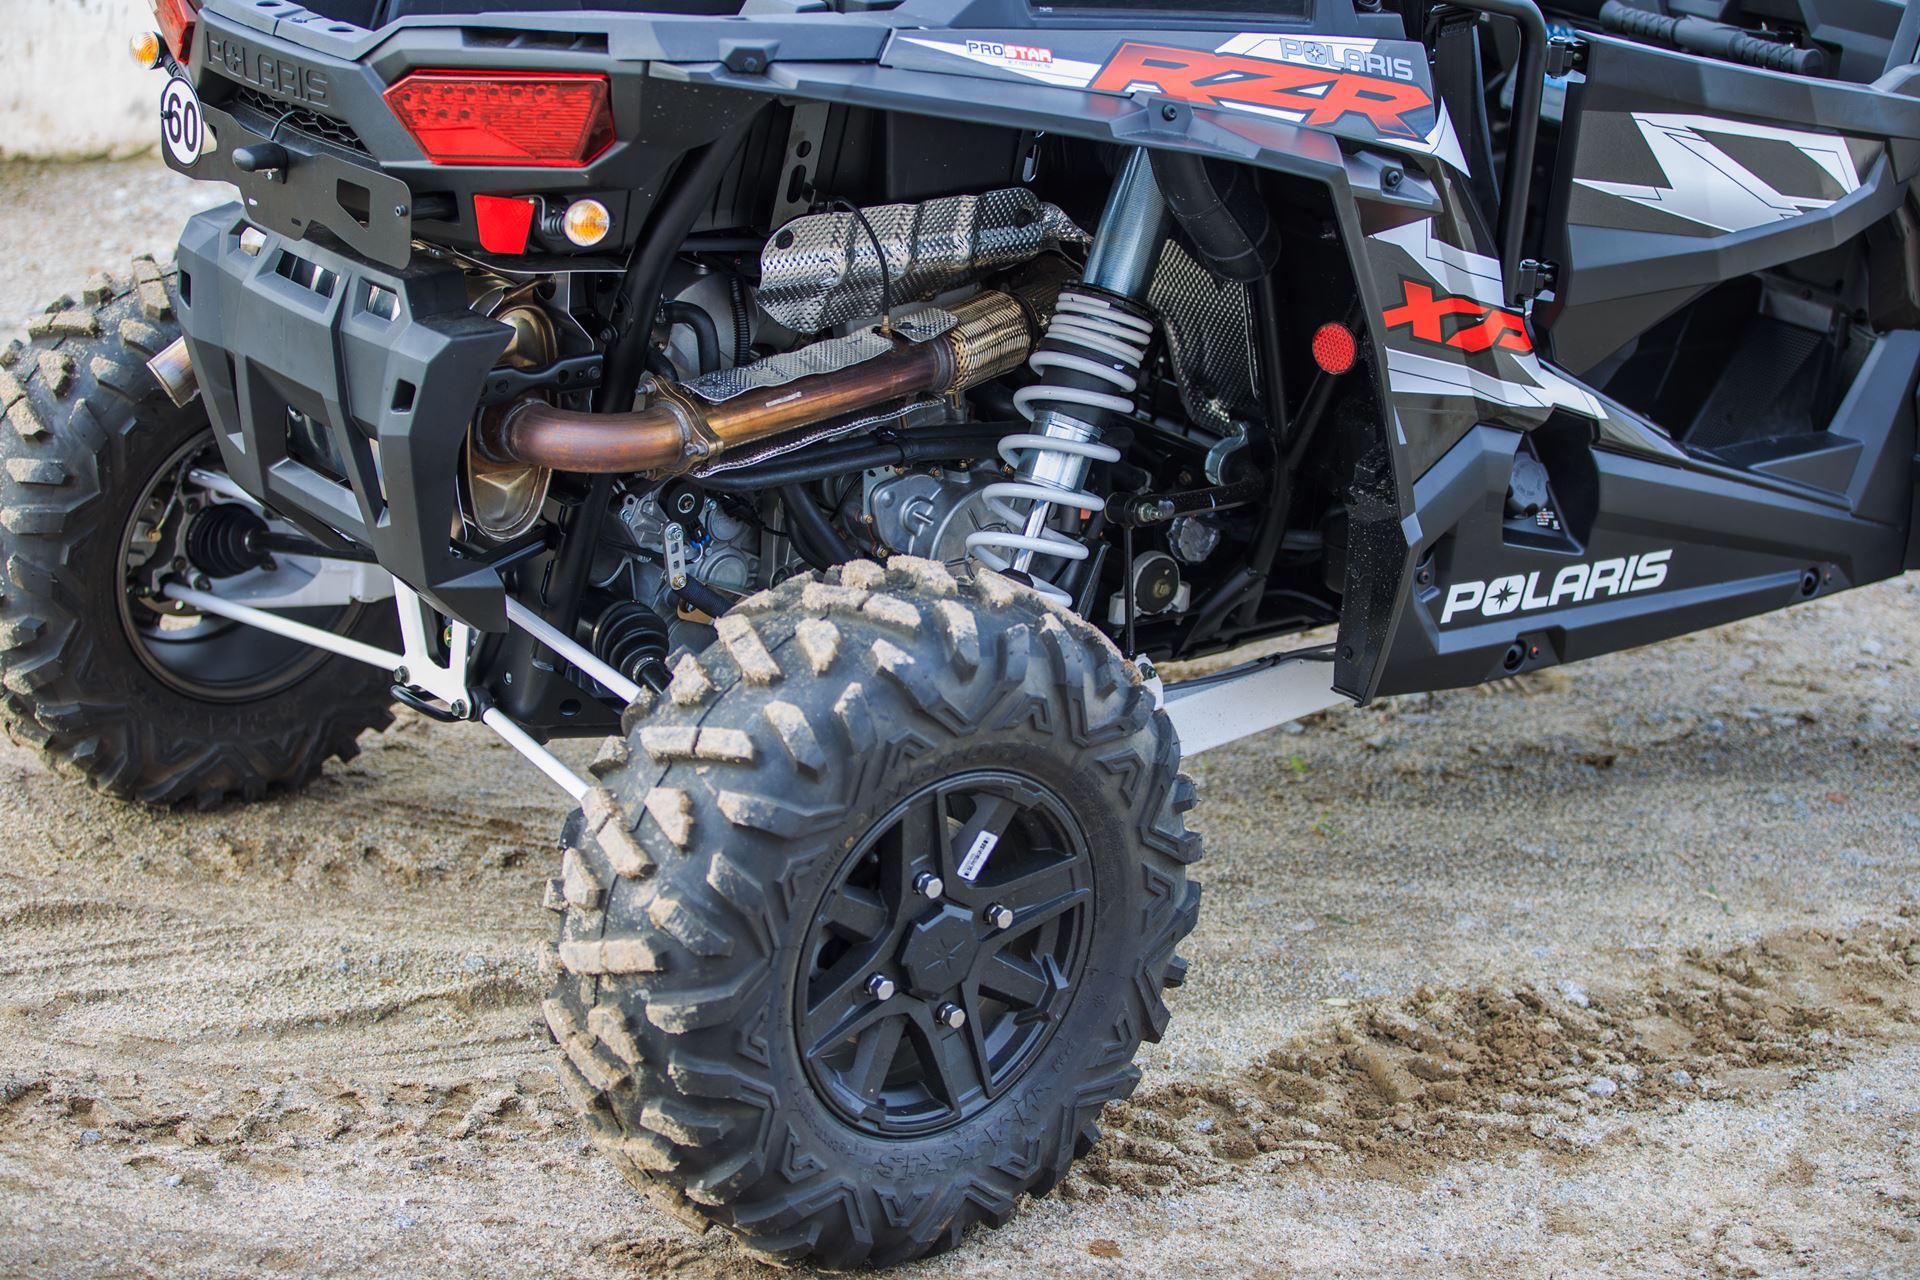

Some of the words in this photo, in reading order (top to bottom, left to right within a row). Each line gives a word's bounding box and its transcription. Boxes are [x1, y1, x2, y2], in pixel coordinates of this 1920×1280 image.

[205, 31, 332, 107] POLARIS
[968, 42, 1052, 63] PROSTAR
[1279, 37, 1414, 81] POLARIS
[168, 92, 197, 152] 60
[1090, 41, 1433, 138] RZR
[1440, 549, 1673, 624] POLARIS
